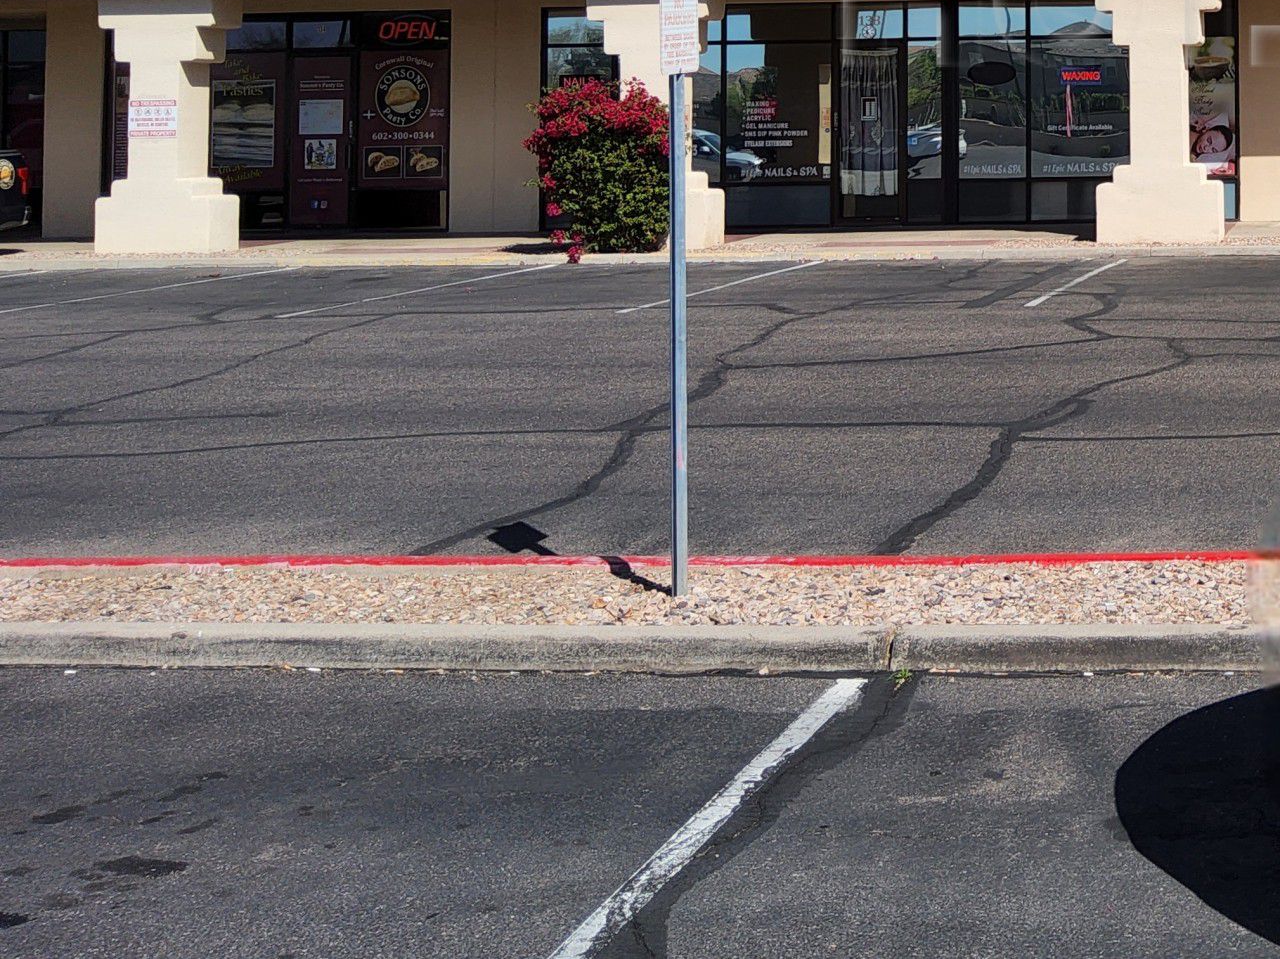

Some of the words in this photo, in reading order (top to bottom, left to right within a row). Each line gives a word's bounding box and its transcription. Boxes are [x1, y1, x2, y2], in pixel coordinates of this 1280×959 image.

[858, 15, 881, 26] 138
[379, 21, 437, 39] OPEN
[379, 68, 427, 91] SONSONS
[1061, 70, 1100, 81] WAXING
[382, 107, 406, 126] Pasty
[1089, 123, 1113, 131] Available
[764, 167, 793, 177] NAILS
[799, 166, 818, 176] SPA
[981, 164, 1003, 174] NAILS
[1007, 164, 1022, 174] SPA
[1066, 162, 1095, 173] NAILS
